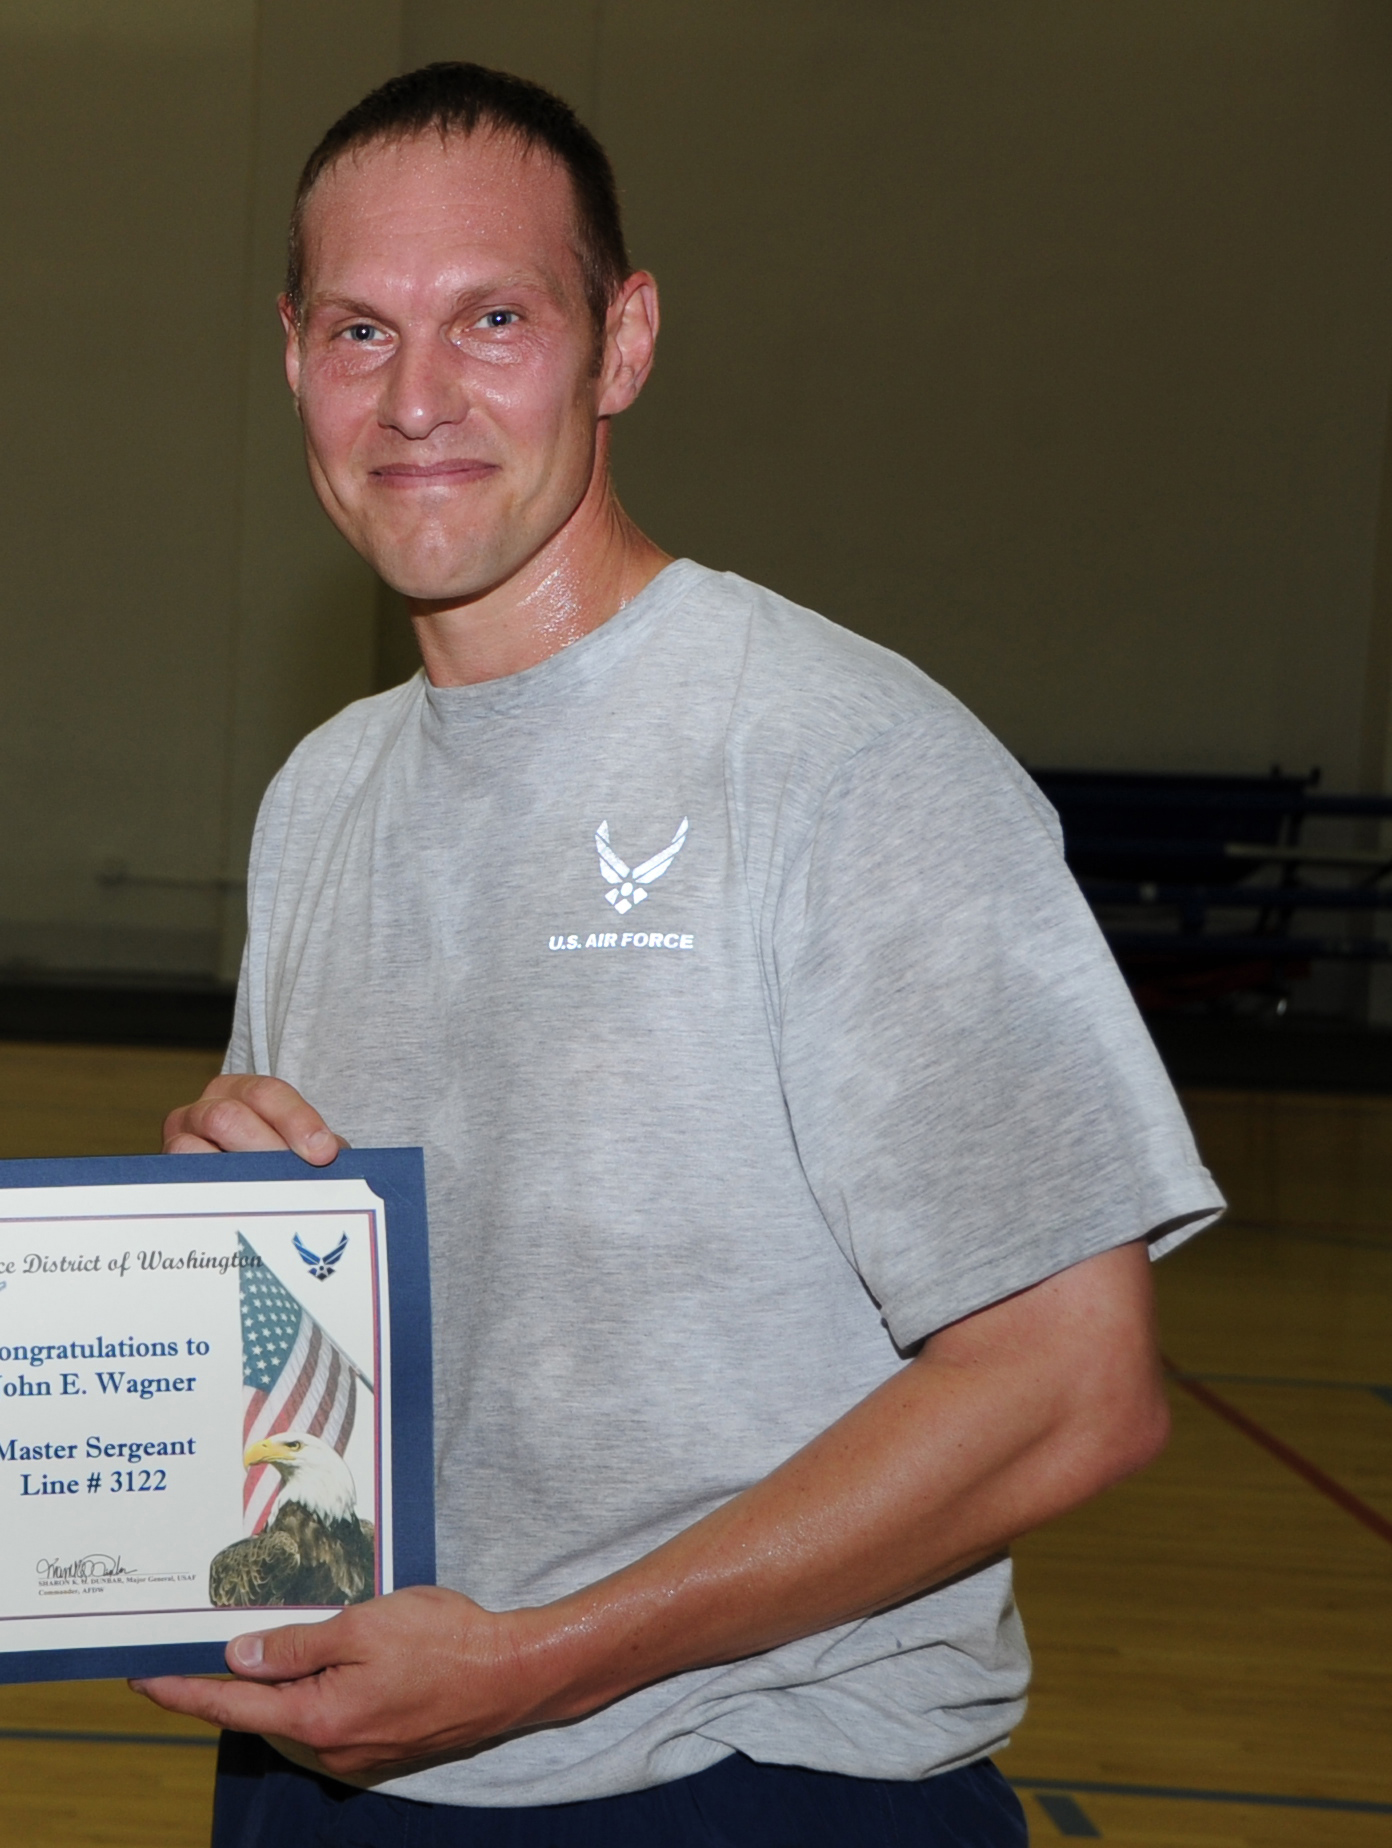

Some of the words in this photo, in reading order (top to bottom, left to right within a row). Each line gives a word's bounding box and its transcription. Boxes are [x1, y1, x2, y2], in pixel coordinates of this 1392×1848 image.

[548, 935, 581, 951] U.S.
[585, 933, 617, 948] AIR
[620, 932, 694, 949] FORCE
[23, 1252, 102, 1275] District
[108, 1251, 132, 1278] of
[137, 1249, 264, 1276] Washington
[186, 1337, 210, 1356] to
[59, 1373, 87, 1395] E.
[95, 1371, 197, 1400] Wagner
[86, 1435, 197, 1464] Sergeant
[20, 1473, 80, 1496] Line
[86, 1471, 102, 1494] #
[110, 1469, 167, 1492] 3122
[126, 1576, 146, 1584] Major
[148, 1575, 175, 1583] General,
[38, 1588, 80, 1597] Commander,
[82, 1586, 104, 1594] AFDW
